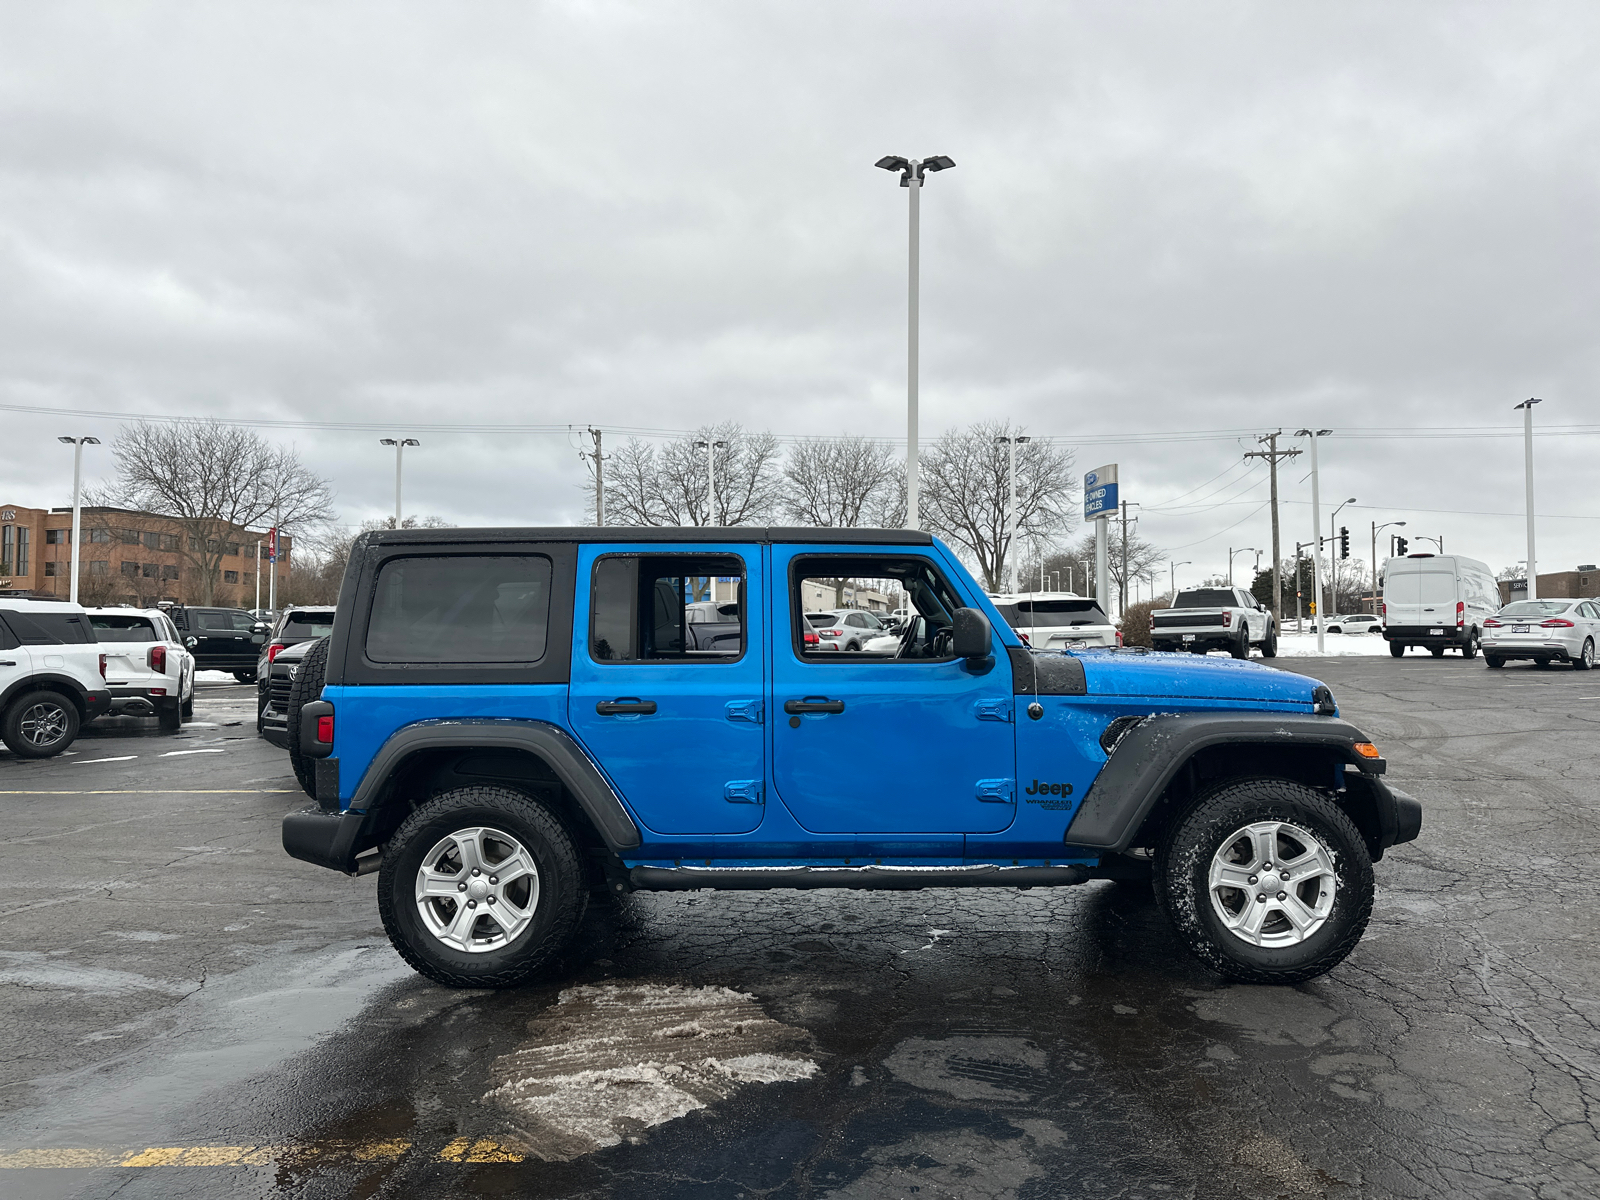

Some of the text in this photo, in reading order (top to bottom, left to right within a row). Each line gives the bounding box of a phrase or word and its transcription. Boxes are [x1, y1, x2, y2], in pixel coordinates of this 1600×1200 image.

[1085, 488, 1106, 502] E-OWNED
[1085, 499, 1103, 513] EHICLES
[1025, 779, 1073, 798] Jeep
